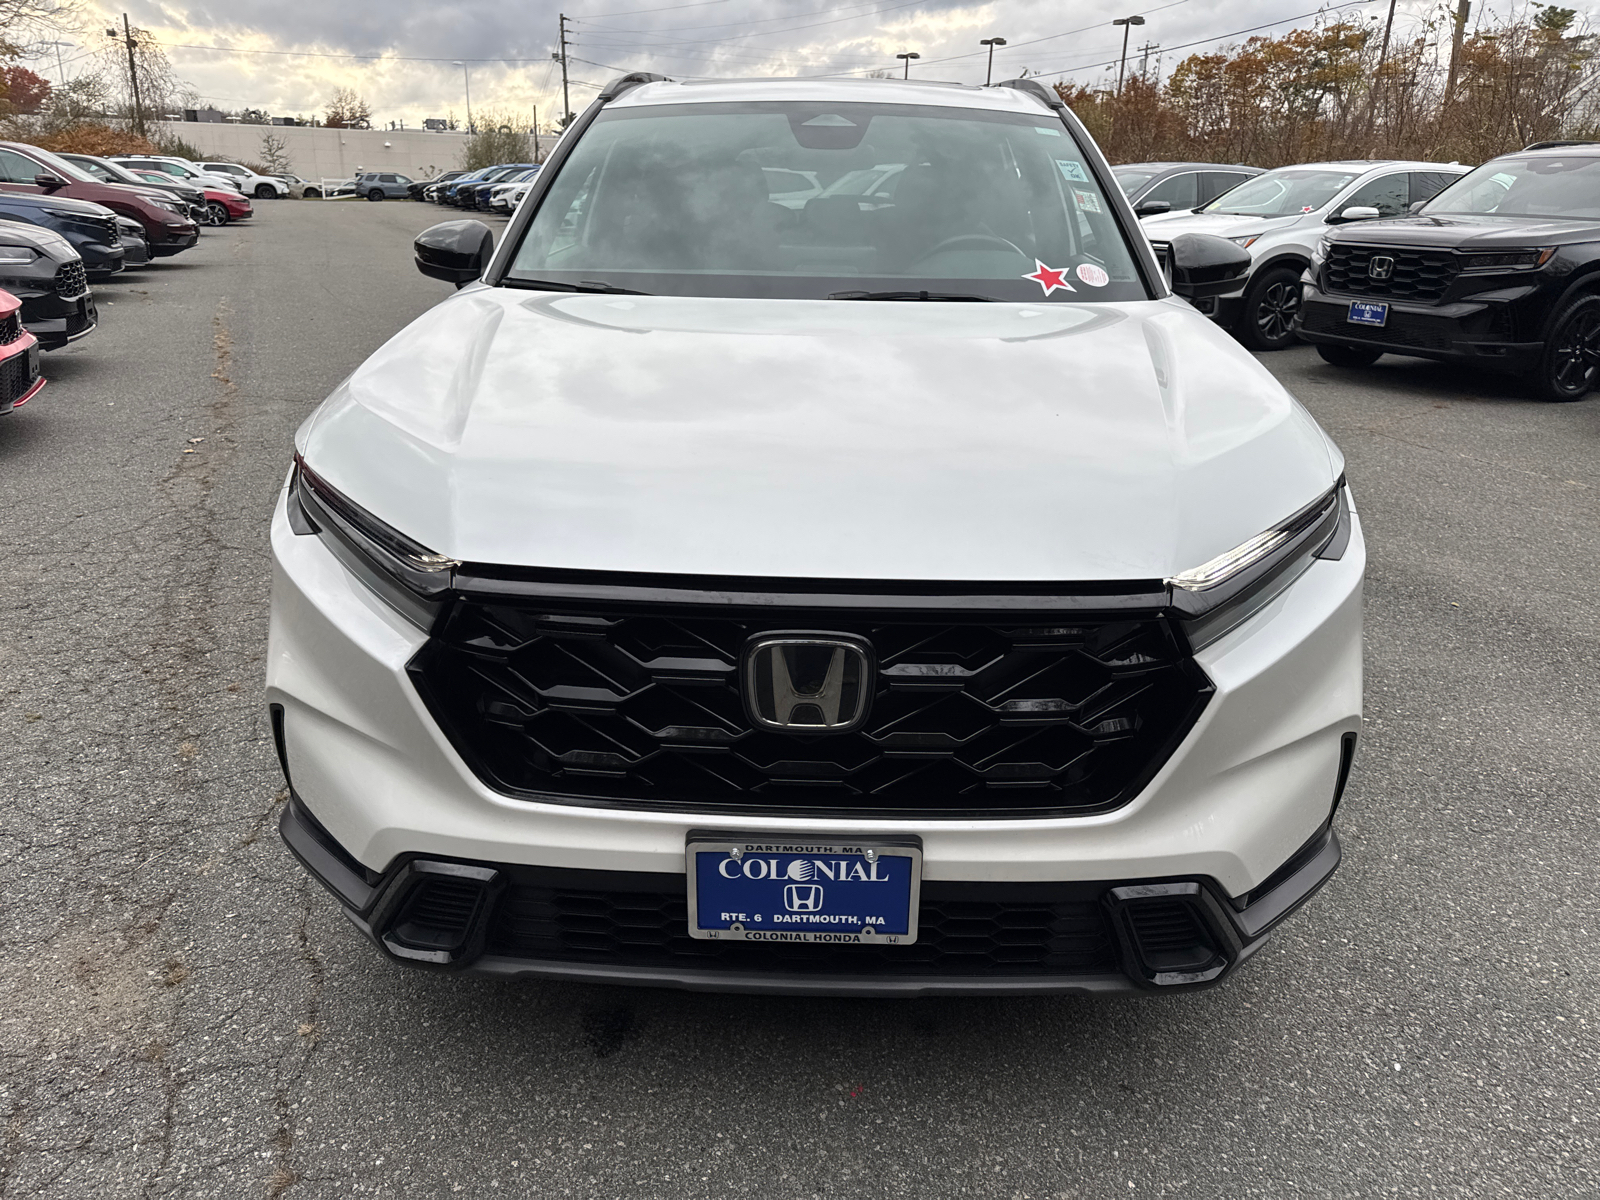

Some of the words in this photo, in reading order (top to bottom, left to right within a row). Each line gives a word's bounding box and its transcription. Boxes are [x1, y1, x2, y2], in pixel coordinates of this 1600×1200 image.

[718, 858, 890, 882] COLONIAL
[721, 912, 751, 922] RTE.
[753, 914, 763, 922] 6
[773, 914, 861, 926] DARTMOUTH,
[865, 916, 886, 925] MA
[745, 932, 810, 942] COLONIAL
[813, 933, 861, 943] HONDA
